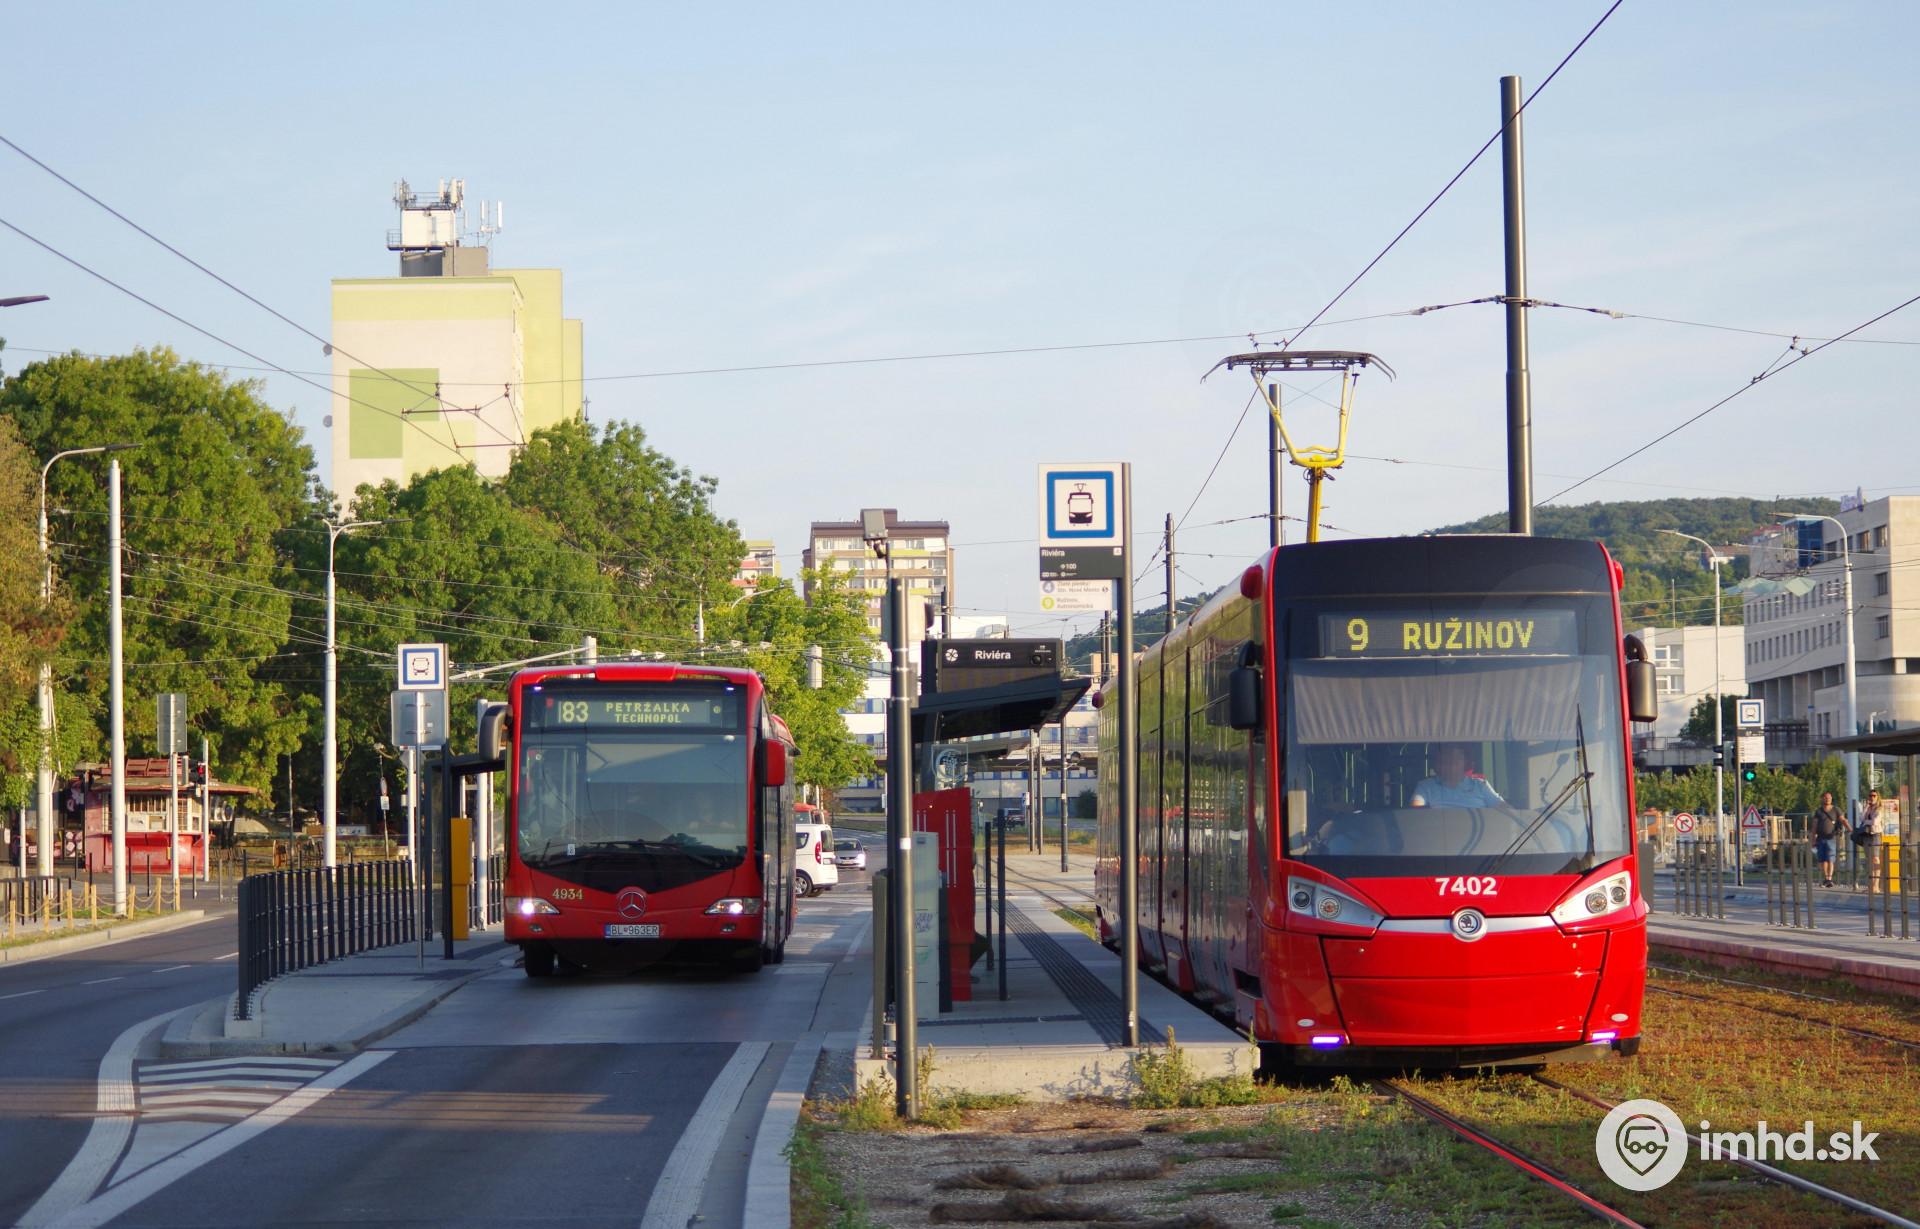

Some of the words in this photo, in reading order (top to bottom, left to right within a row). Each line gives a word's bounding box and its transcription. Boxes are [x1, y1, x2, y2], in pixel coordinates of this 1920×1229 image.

[1041, 549, 1065, 557] Riviéra
[1347, 618, 1369, 651] 9
[1403, 617, 1534, 650] RUŽINOV
[975, 650, 1011, 660] Riviéra
[562, 701, 589, 723] 83
[615, 713, 681, 723] TECHNOPOL
[1435, 876, 1498, 896] 7402
[552, 888, 583, 900] 4934
